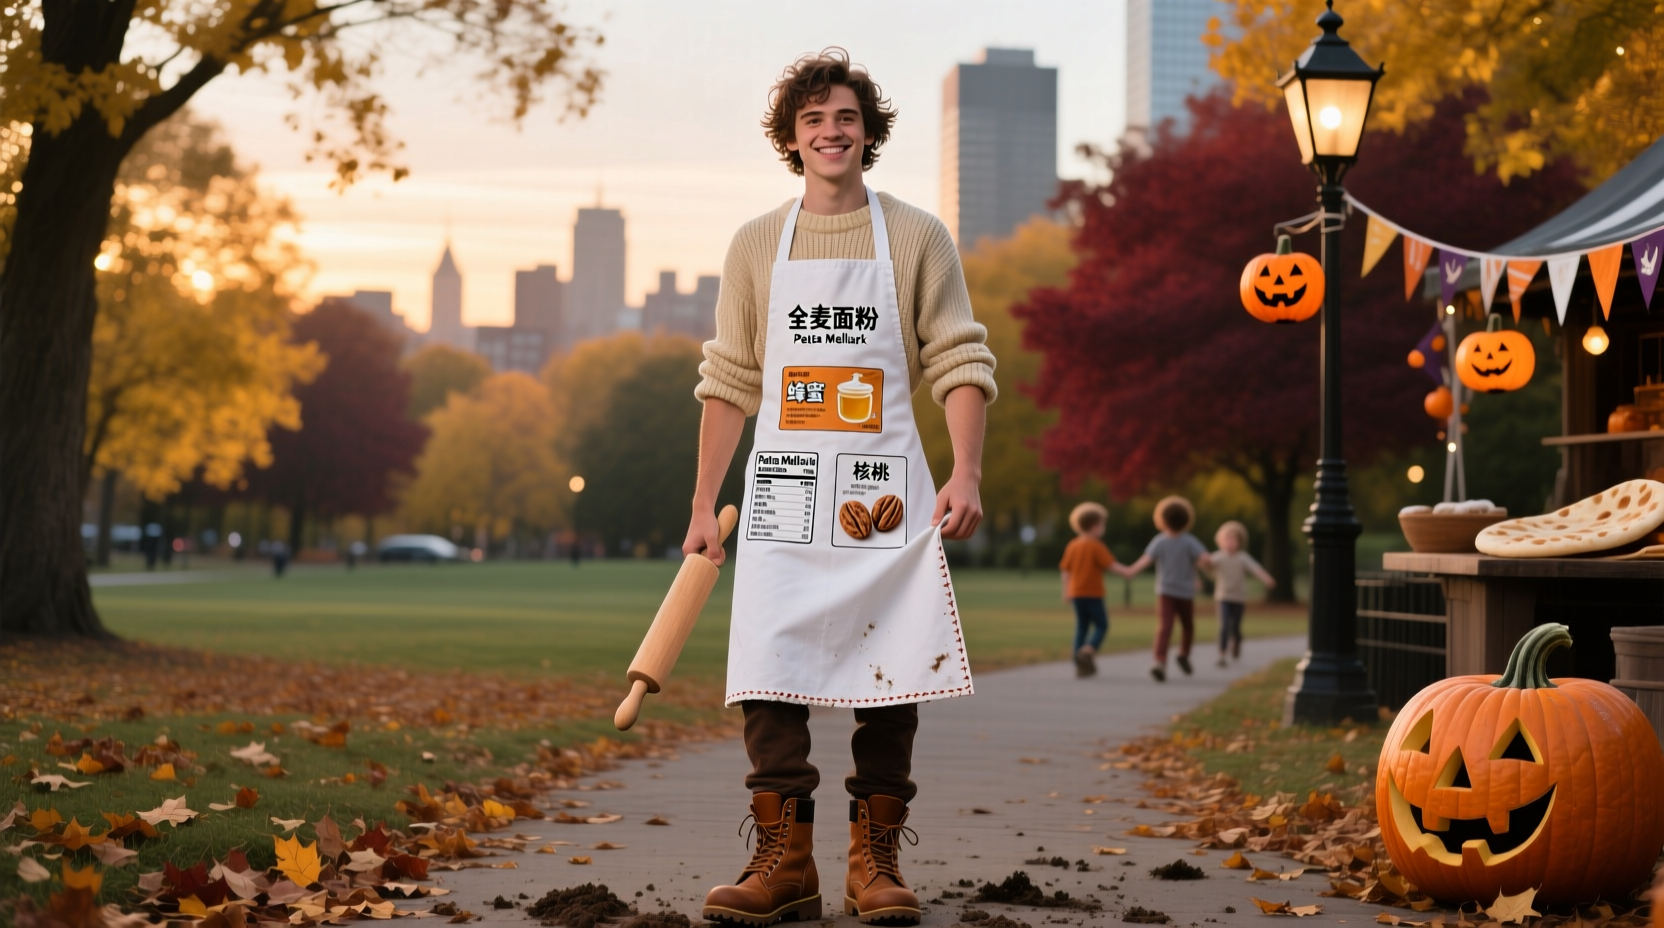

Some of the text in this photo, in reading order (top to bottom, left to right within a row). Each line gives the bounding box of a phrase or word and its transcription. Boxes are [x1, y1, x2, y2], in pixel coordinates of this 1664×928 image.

[788, 303, 879, 331] 全麦面粉
[853, 461, 889, 481] 核桃
